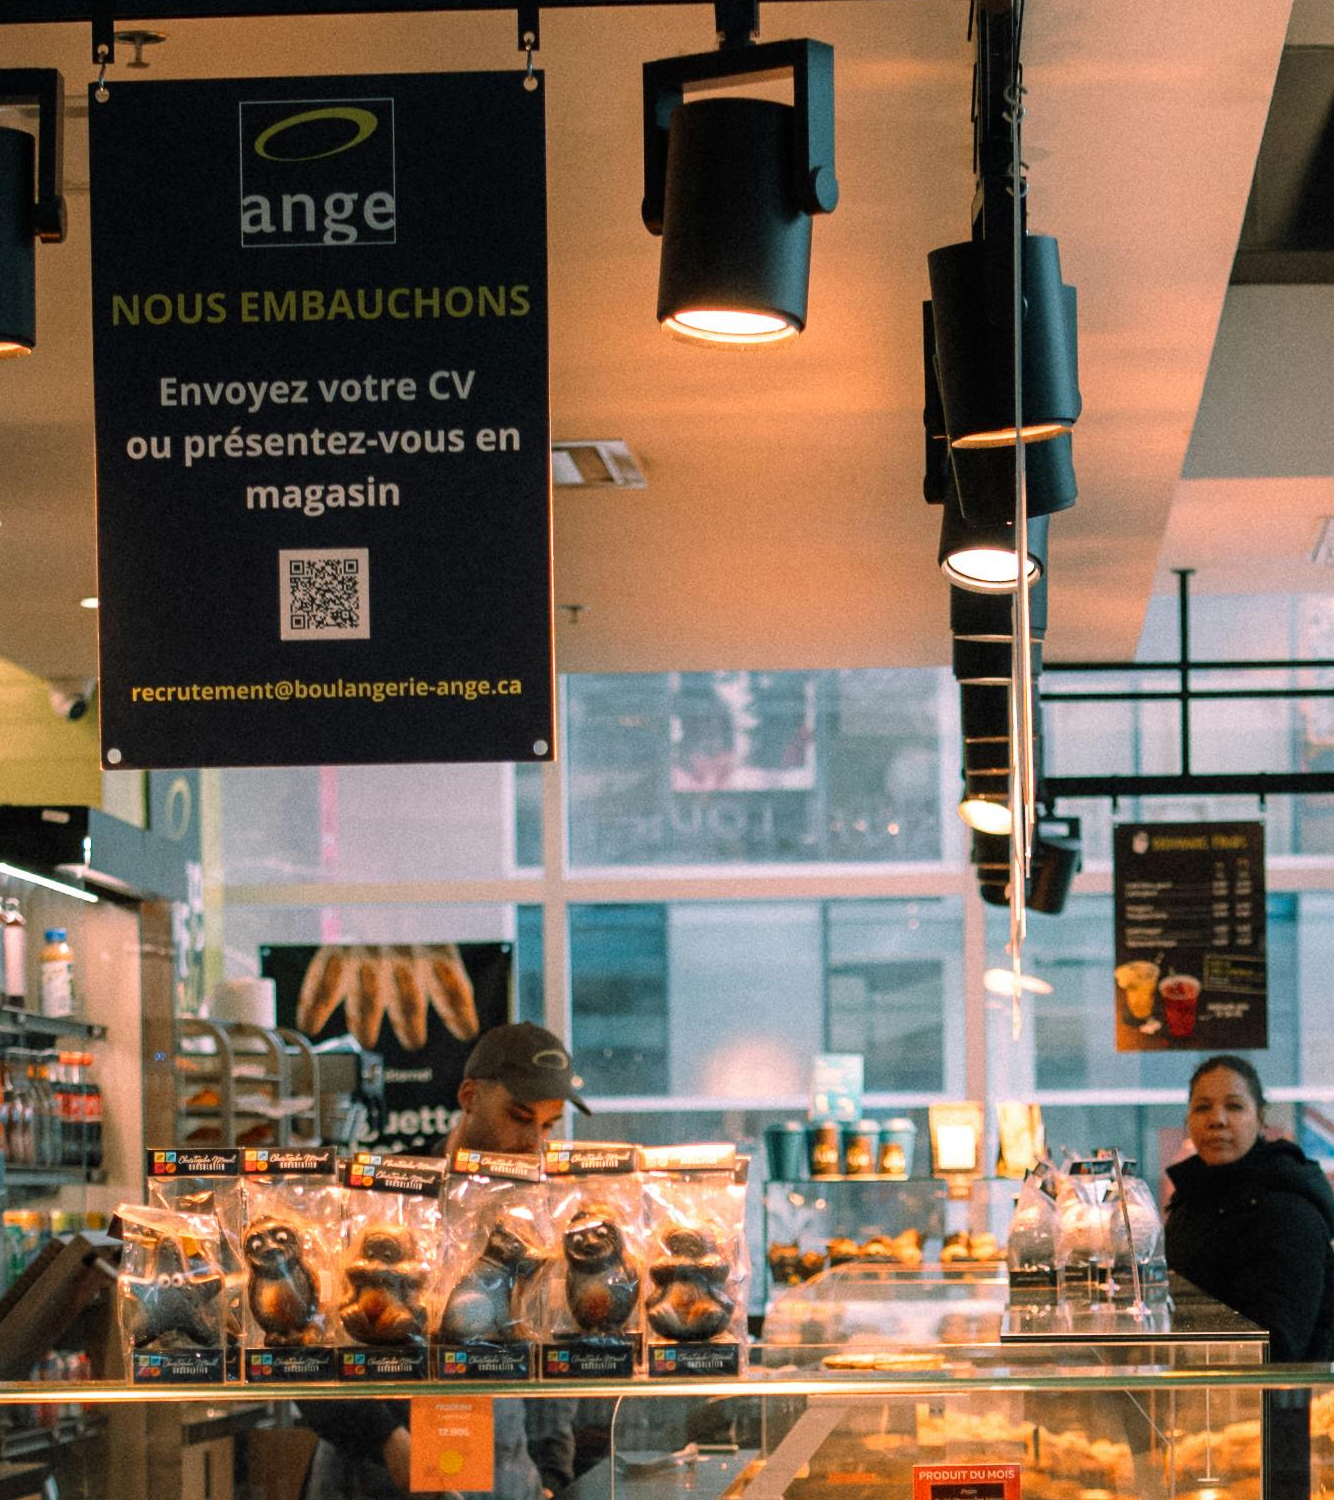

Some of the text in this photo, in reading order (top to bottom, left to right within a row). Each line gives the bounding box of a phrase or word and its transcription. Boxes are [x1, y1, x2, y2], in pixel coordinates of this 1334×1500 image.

[240, 188, 397, 244] ange
[111, 285, 531, 326] NOUS EMBAUCHONS
[159, 370, 476, 412] Envoyez votre CV
[126, 426, 520, 467] ou présentez-vous en
[246, 476, 400, 516] magasin
[131, 676, 522, 703] recrutement@boulangerie-ange.ca
[919, 1470, 1015, 1480] PRODUIT DU MOIS
